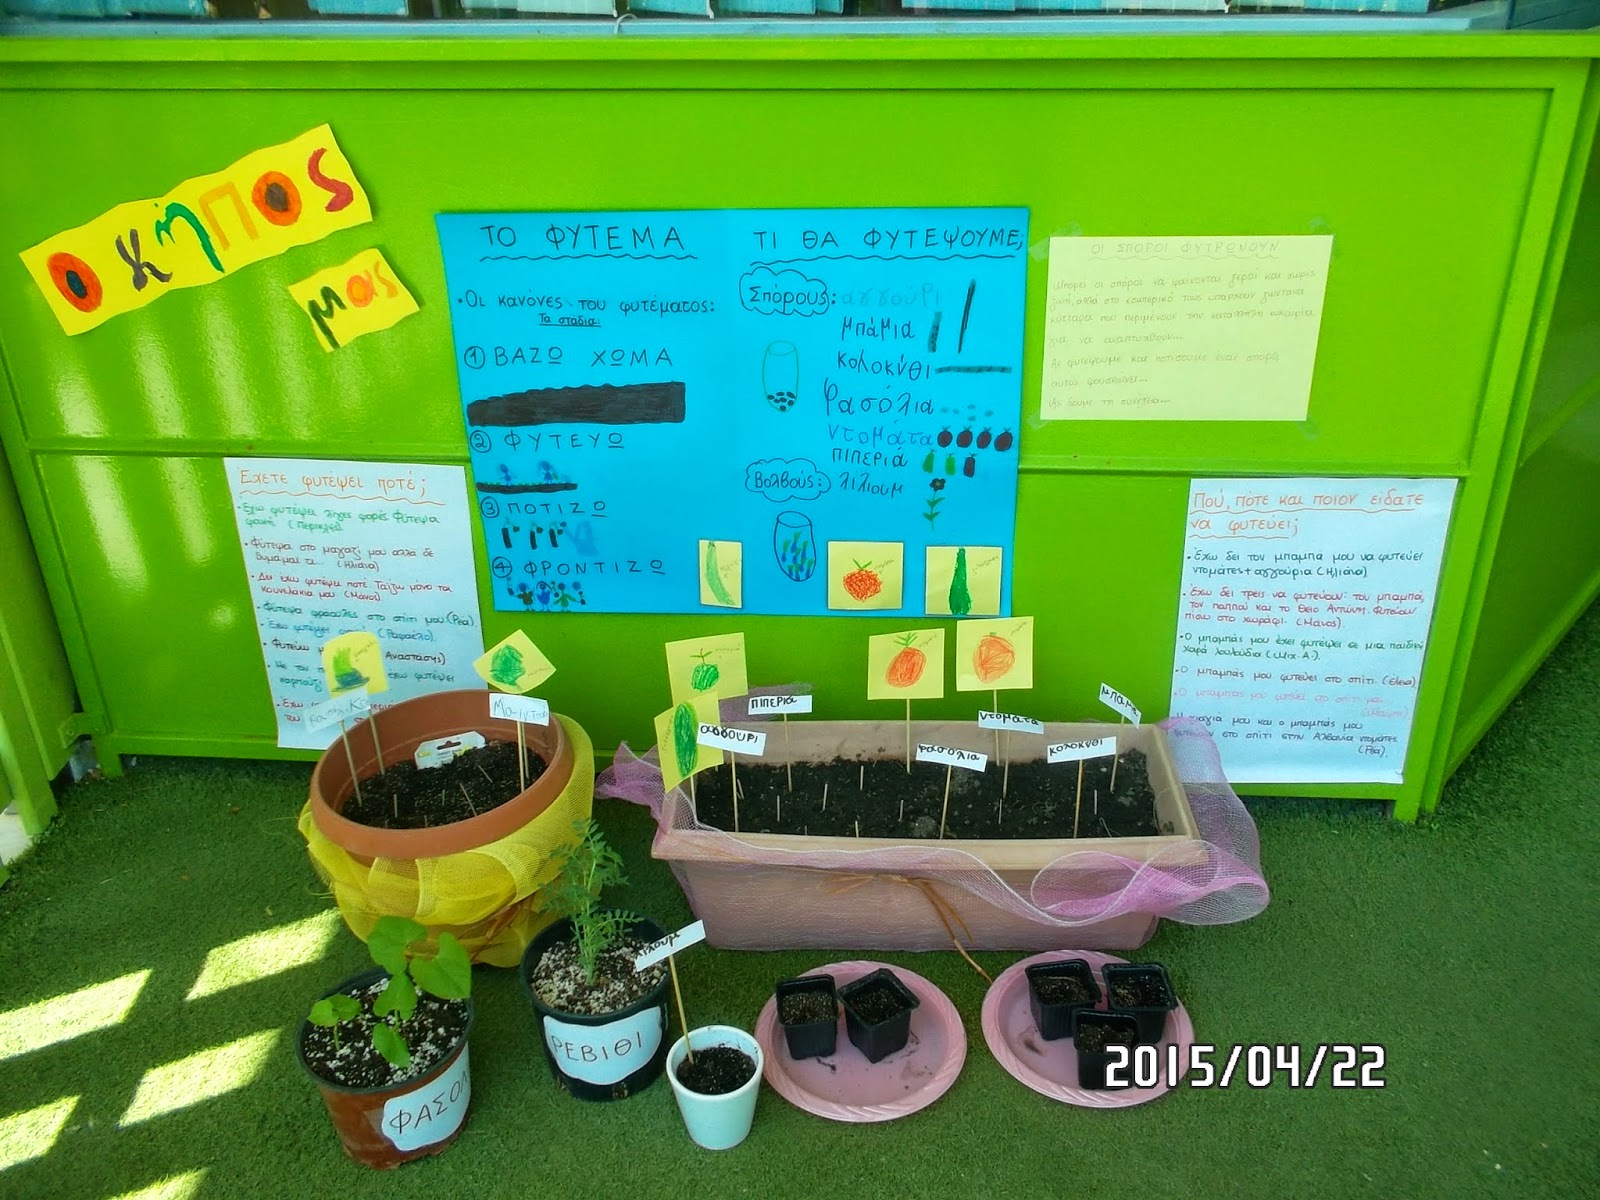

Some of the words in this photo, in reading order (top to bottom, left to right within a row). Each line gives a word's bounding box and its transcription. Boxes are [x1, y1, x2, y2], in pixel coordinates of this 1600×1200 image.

[480, 225, 517, 247] ΤΟ
[546, 223, 685, 251] ΦΥΤΕΜΑ
[754, 231, 777, 250] ΤΙ
[802, 230, 839, 248] ΘΑ
[863, 226, 1024, 251] ΦΥΤΕΨΟΥΜΕ;
[465, 289, 487, 308] Οι
[498, 289, 563, 310] κανόνες
[578, 300, 606, 312] του
[619, 294, 716, 318] φυτέματος:
[538, 312, 552, 324] Τα
[495, 345, 563, 367] ΒΑΖΩ
[591, 347, 674, 368] ΧΩΜΑ
[504, 430, 625, 450] ΦΥΤΕΥΩ
[301, 470, 365, 492] φυτέψει
[1279, 494, 1305, 506] και
[508, 500, 607, 518] ΠΟΤΙΖΩ
[1190, 518, 1212, 530] να
[1225, 549, 1241, 562] δει
[1247, 553, 1266, 562] τον
[1332, 552, 1356, 565] μου
[524, 559, 666, 578] ΦΡΟΝΤΙΖΩ
[1220, 585, 1235, 598] δει
[1216, 614, 1237, 623] στο
[1250, 636, 1270, 646] μου
[1324, 675, 1343, 684] στο
[1232, 715, 1251, 727] μου
[1222, 730, 1239, 739] στο
[550, 1030, 644, 1063] ΡΕΒΙΘΙ
